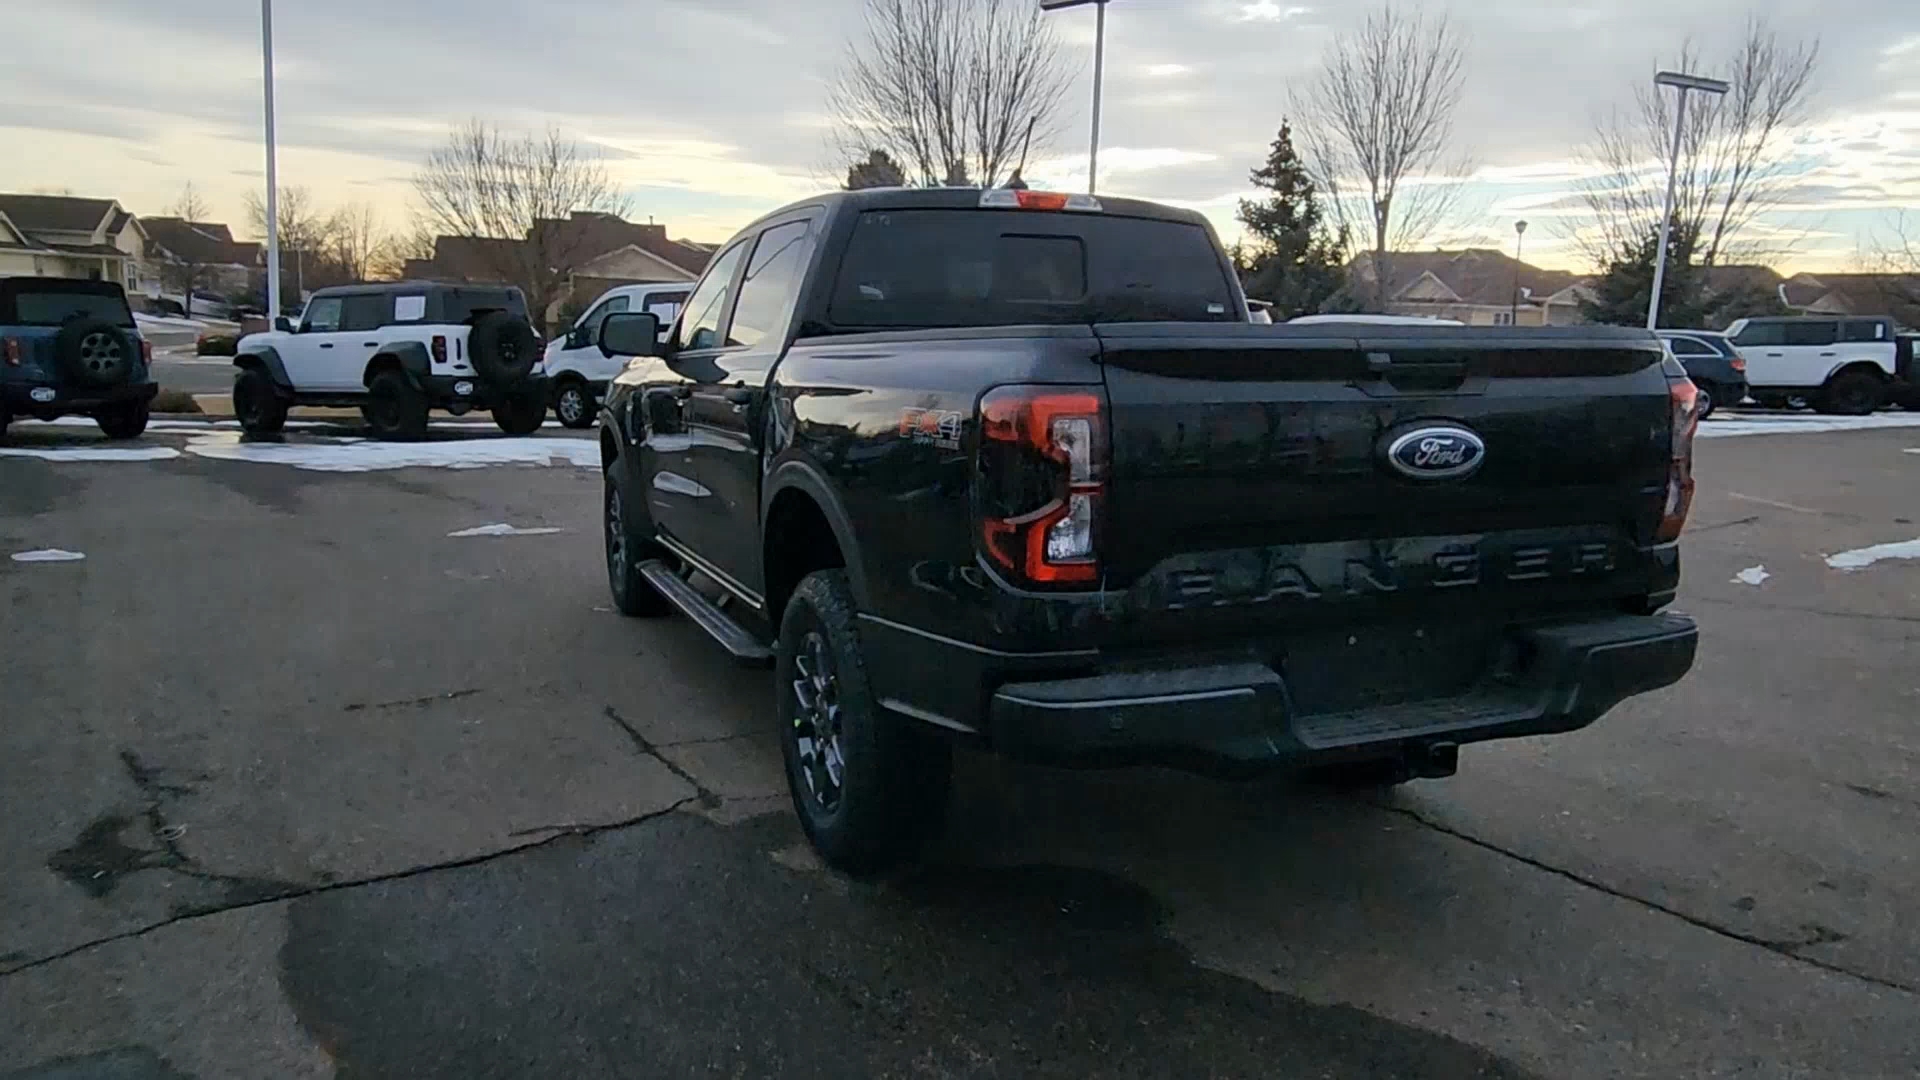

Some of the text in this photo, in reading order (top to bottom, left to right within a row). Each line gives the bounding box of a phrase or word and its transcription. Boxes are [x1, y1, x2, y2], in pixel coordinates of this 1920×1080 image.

[899, 406, 963, 441] FX4
[1415, 438, 1466, 466] Ford
[1167, 542, 1616, 609] RANGER
